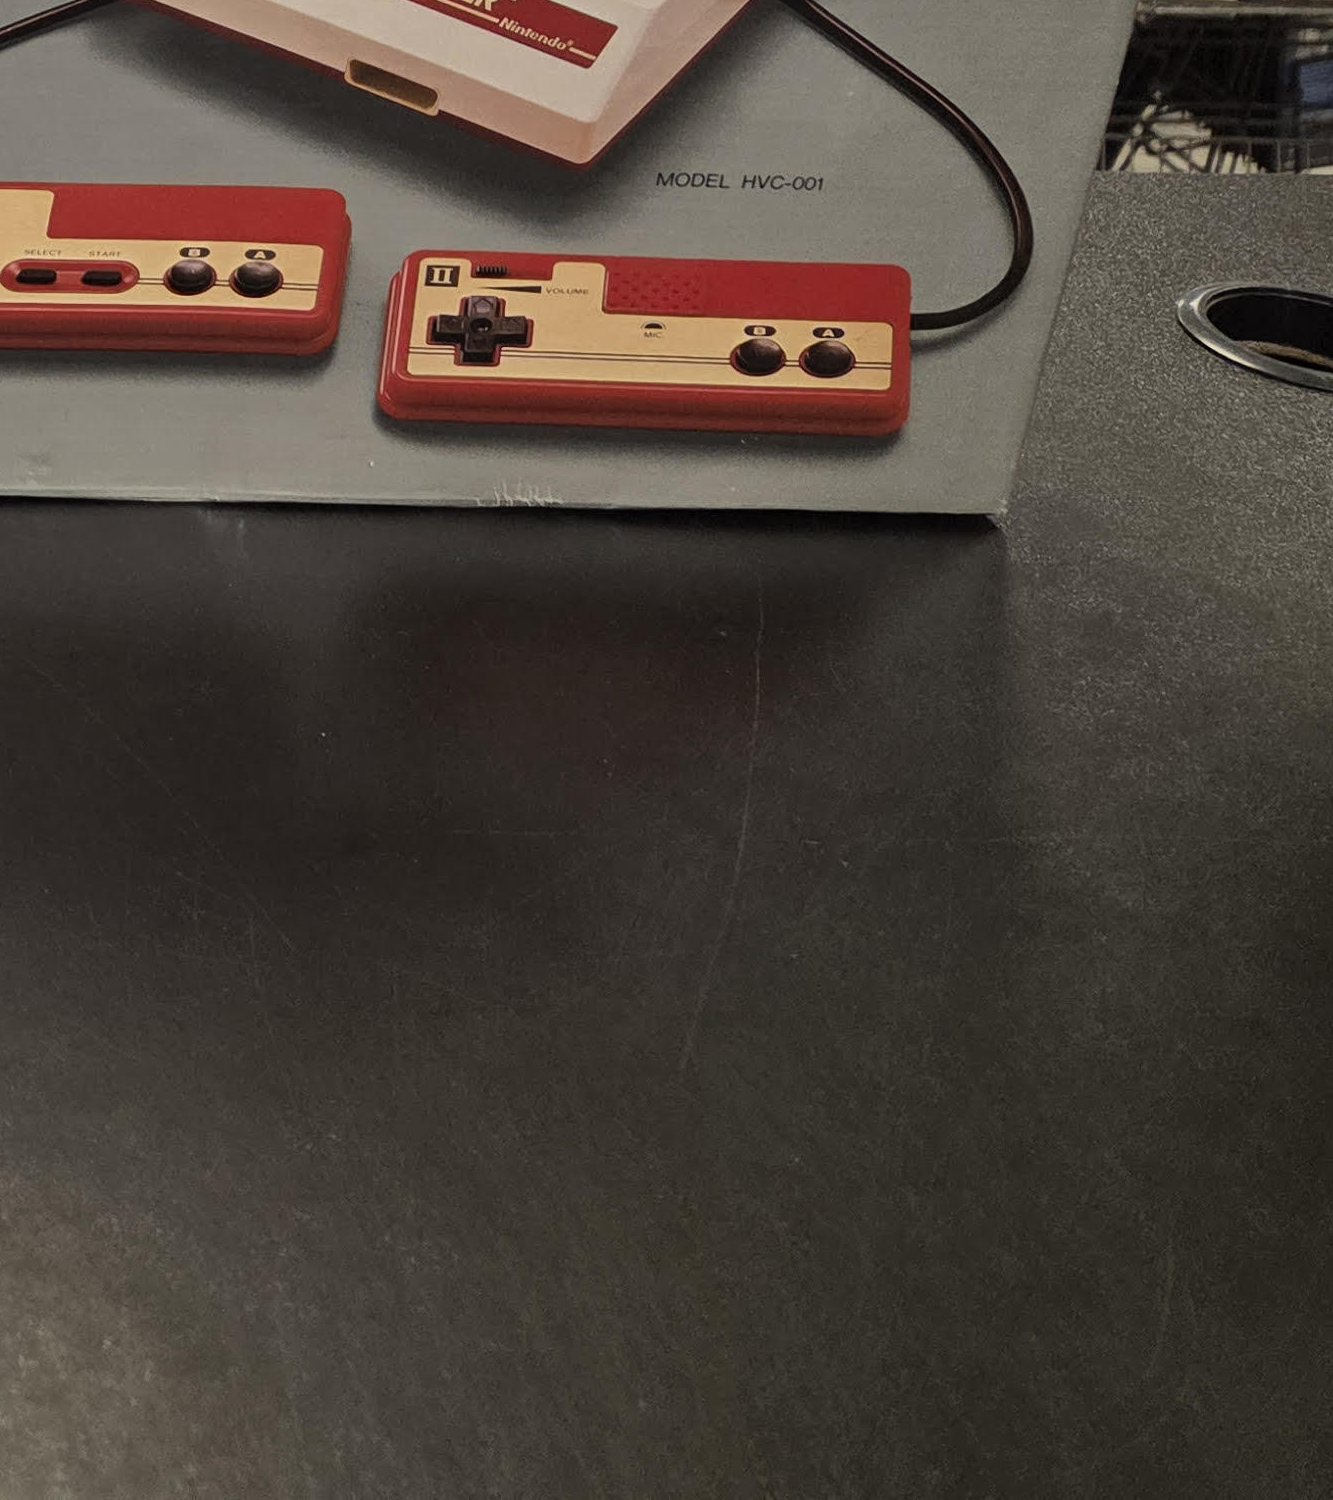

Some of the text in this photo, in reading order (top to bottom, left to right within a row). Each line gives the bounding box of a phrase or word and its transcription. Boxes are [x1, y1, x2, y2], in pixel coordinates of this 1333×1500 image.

[656, 172, 825, 191] MODEL HVC-001
[24, 248, 62, 257] SELECT
[546, 287, 589, 295] VOLUME
